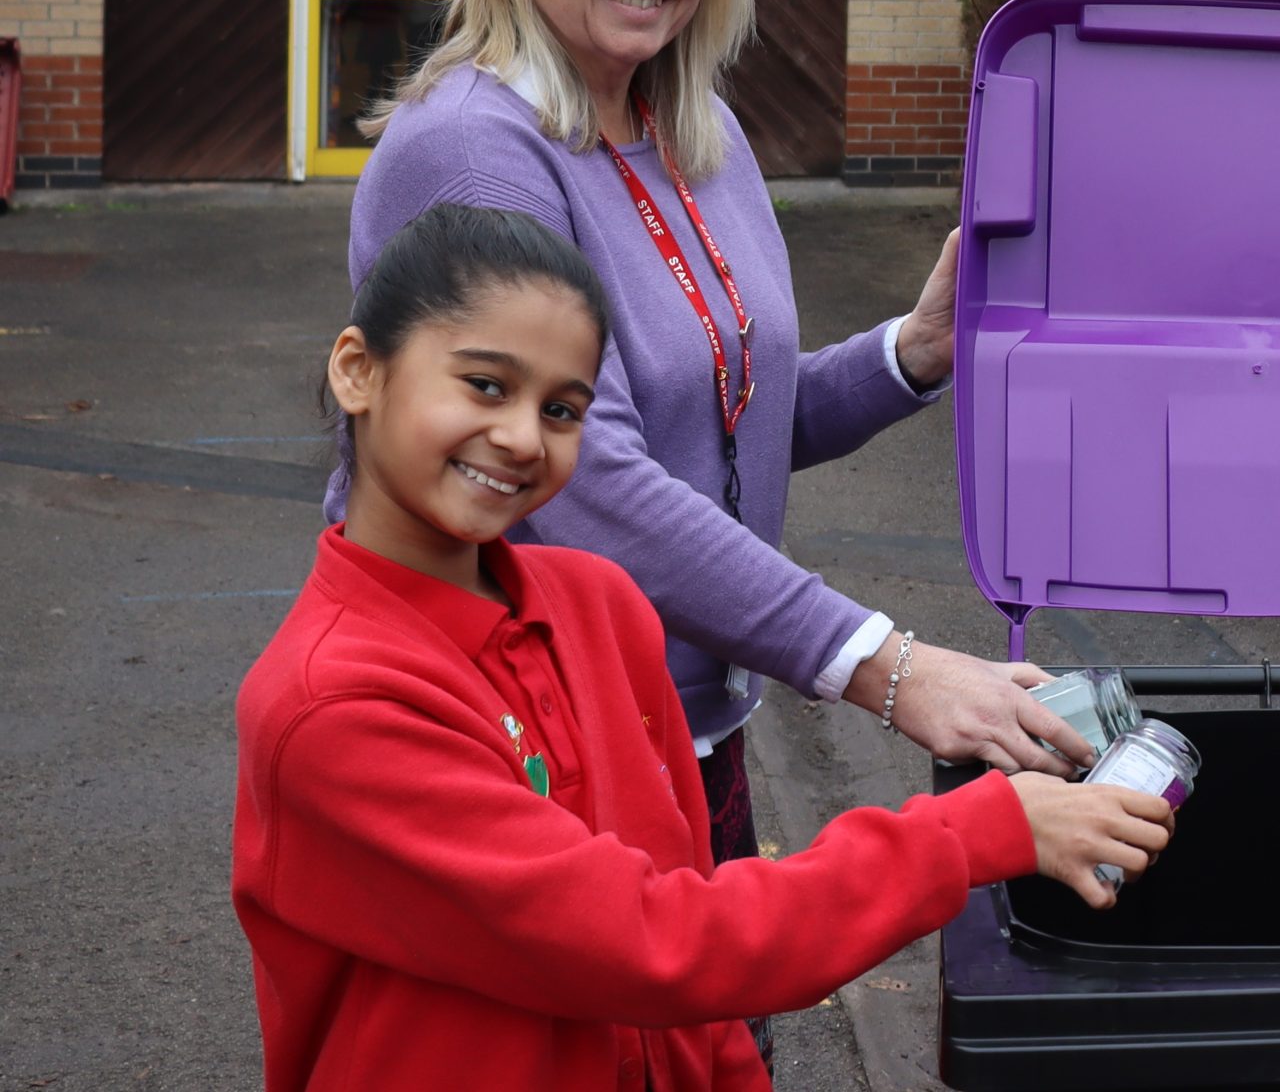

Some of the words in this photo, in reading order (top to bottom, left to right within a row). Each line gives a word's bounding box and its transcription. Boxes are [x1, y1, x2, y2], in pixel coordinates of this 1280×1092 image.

[607, 146, 631, 179] TAFF
[637, 199, 665, 237] STAFF
[668, 256, 696, 294] STAFF
[726, 278, 744, 316] STAFF
[702, 315, 721, 355] STAFF
